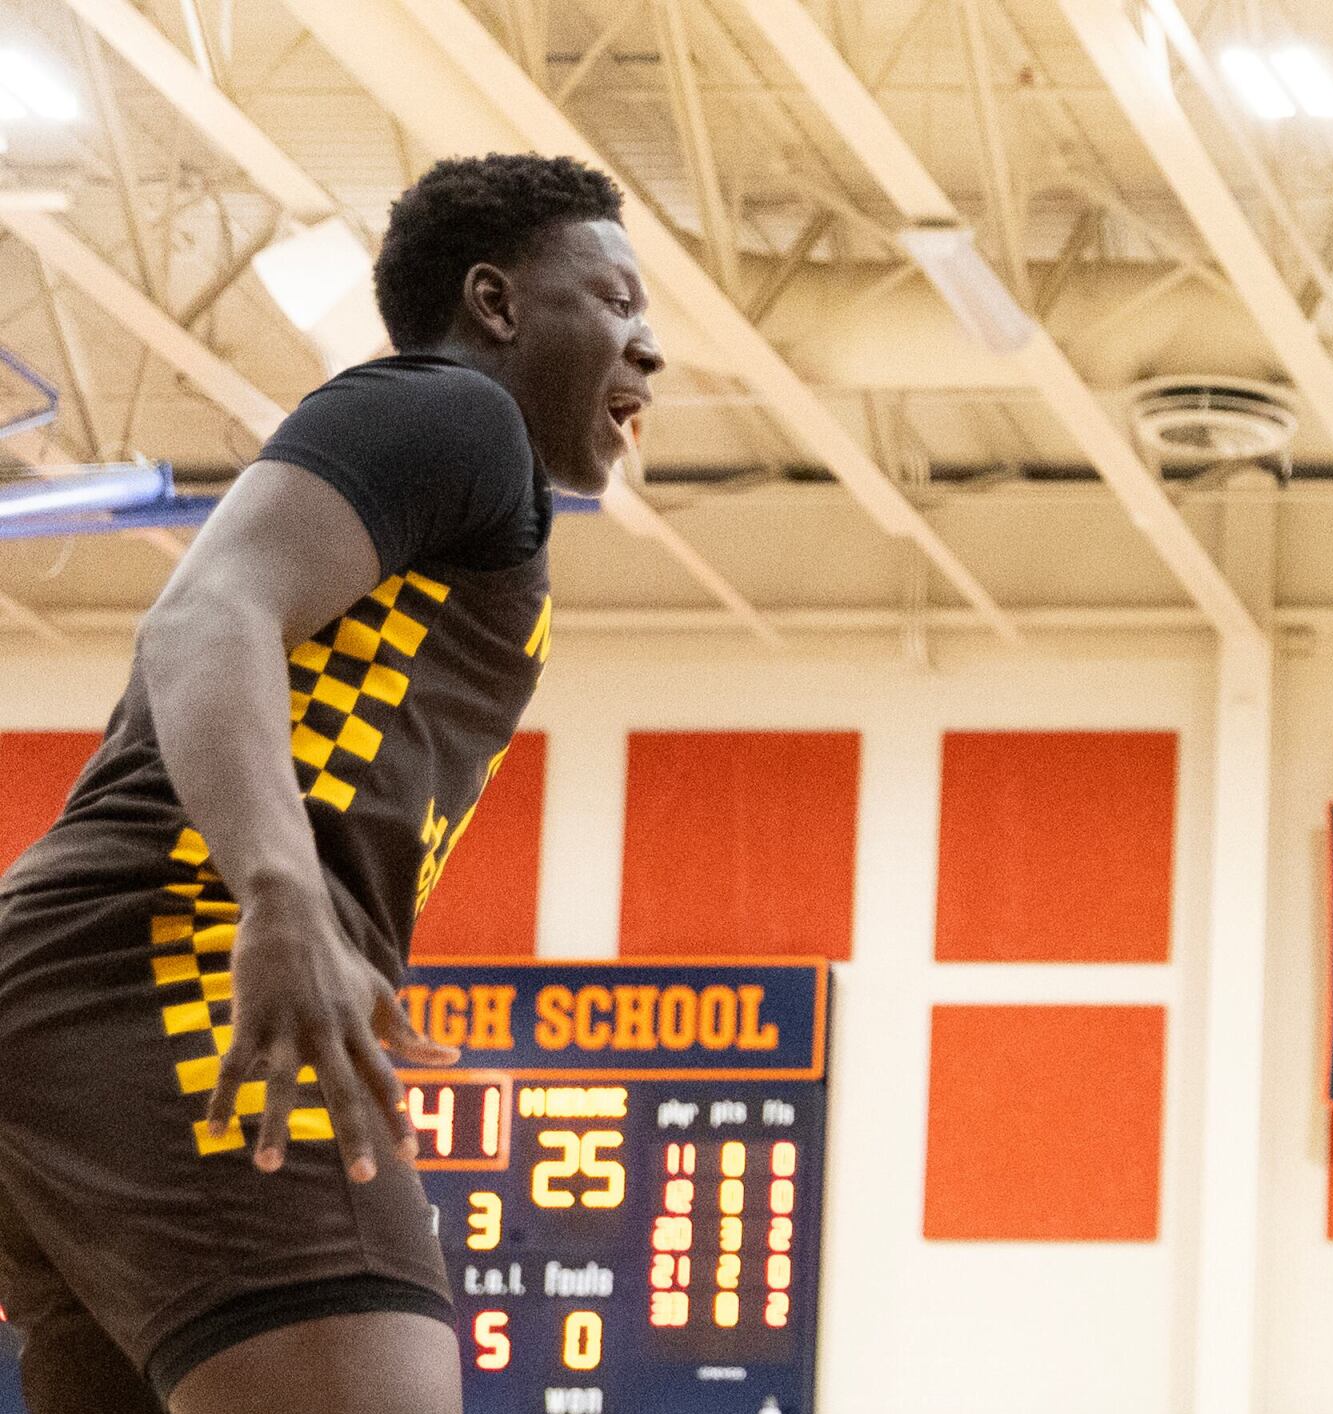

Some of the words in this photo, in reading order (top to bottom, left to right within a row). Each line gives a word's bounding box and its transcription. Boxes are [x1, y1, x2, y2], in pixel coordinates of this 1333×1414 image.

[392, 984, 517, 1050] IGH
[534, 984, 780, 1051] SCHOOL
[531, 1129, 627, 1209] 25
[666, 1142, 697, 1176] 11
[720, 1141, 747, 1178] 0
[770, 1141, 797, 1179] 0
[465, 1191, 503, 1251] 3
[719, 1178, 745, 1216] 0
[769, 1178, 796, 1216] 0
[719, 1215, 744, 1253] 3
[767, 1215, 794, 1253] 2
[649, 1252, 692, 1290] 21
[715, 1252, 742, 1290] 2
[765, 1253, 792, 1291] 0
[763, 1290, 790, 1328] 2
[472, 1309, 512, 1372] 5
[562, 1309, 604, 1372] 0
